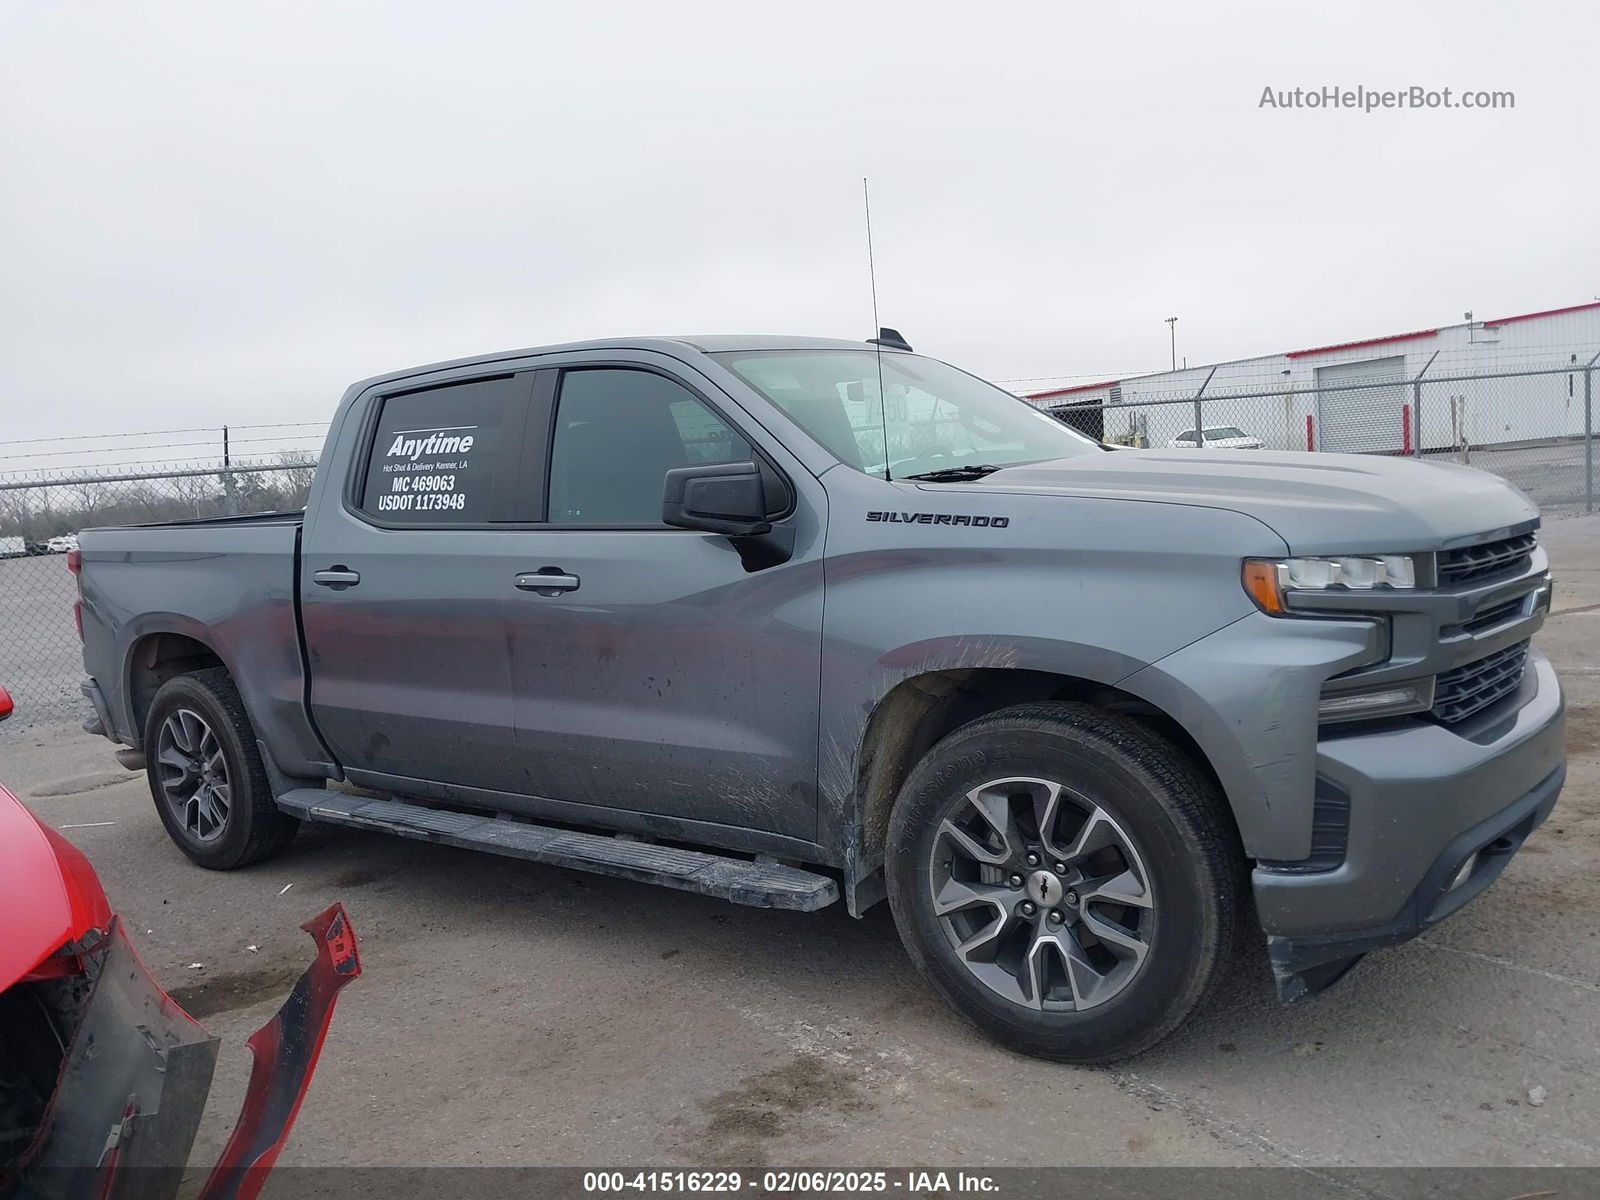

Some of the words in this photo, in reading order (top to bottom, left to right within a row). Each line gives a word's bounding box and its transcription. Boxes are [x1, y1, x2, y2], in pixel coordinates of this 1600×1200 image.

[386, 432, 474, 461] Anytime
[383, 464, 393, 472] Hot
[393, 463, 406, 472] Shot
[406, 462, 411, 471] &
[412, 462, 435, 472] Delivery
[459, 460, 468, 469] LA
[392, 476, 410, 492] MC
[411, 475, 455, 492] 469063
[378, 494, 415, 511] USDOT
[415, 493, 466, 510] 1173948
[866, 511, 1010, 528] SILVERADO
